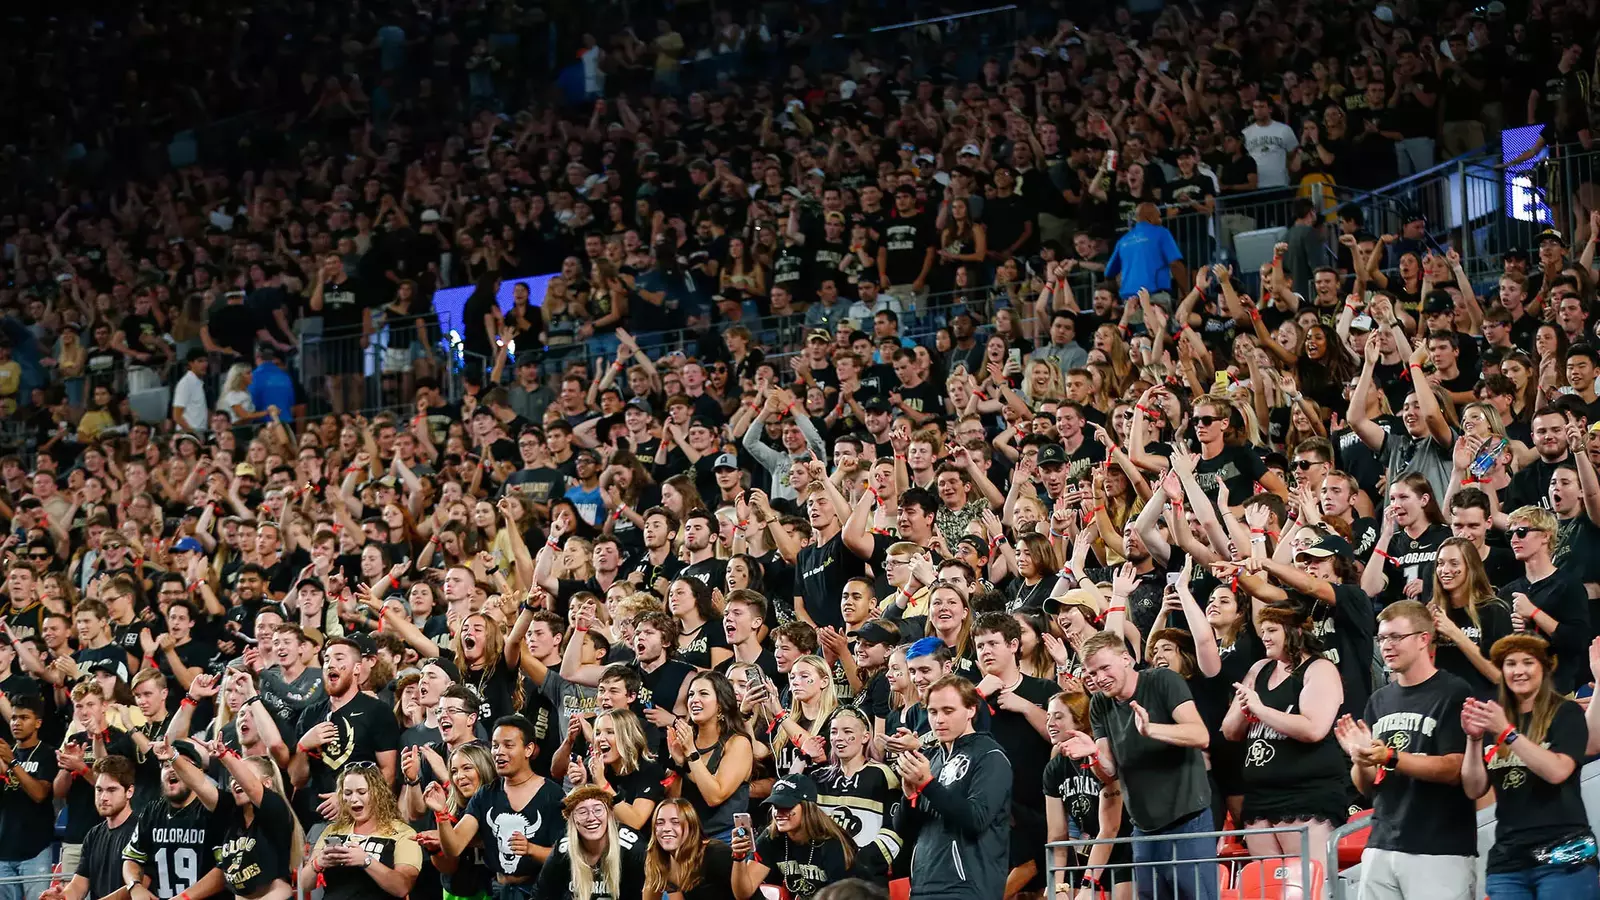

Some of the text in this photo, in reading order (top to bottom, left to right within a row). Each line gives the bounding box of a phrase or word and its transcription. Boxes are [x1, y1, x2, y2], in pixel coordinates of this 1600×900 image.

[563, 695, 599, 709] COLORA
[153, 828, 205, 844] COLORADO
[155, 847, 197, 898] 19
